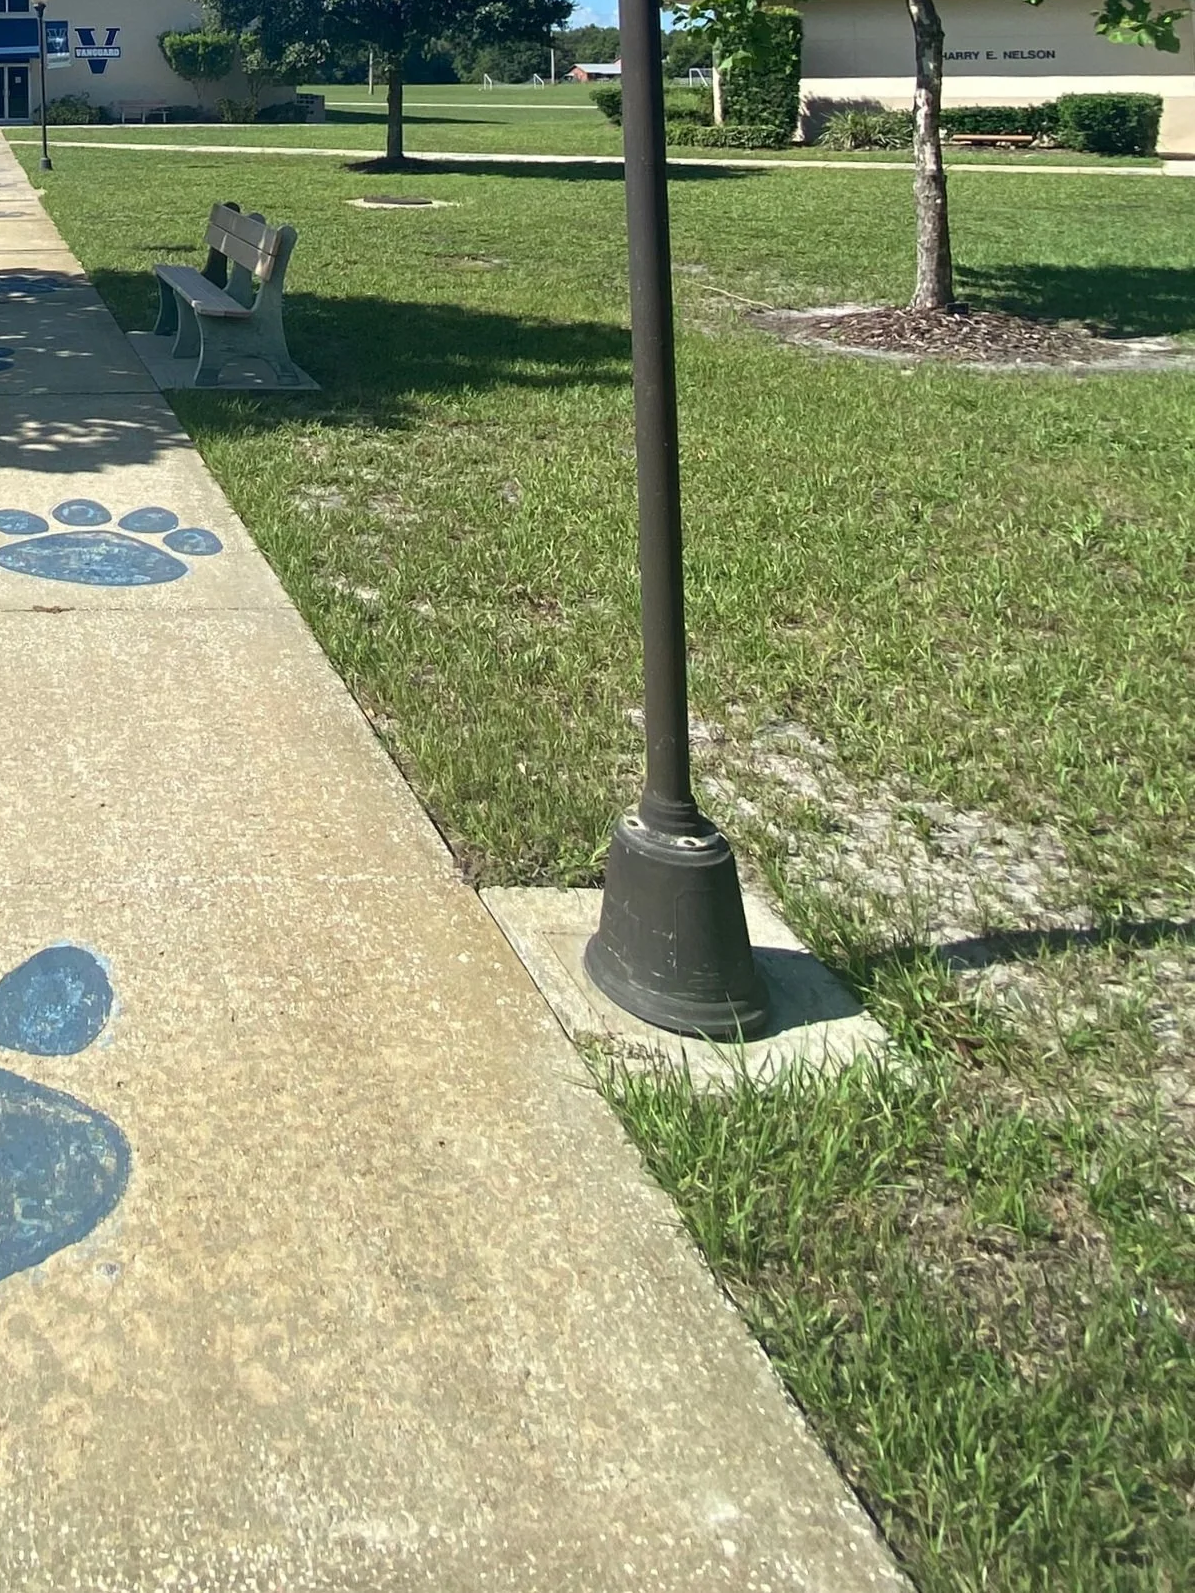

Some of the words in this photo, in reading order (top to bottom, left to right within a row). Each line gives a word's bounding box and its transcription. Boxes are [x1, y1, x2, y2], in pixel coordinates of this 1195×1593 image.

[75, 48, 120, 57] VANGUARD
[986, 50, 998, 60] E.
[1003, 50, 1056, 60] NELSON
